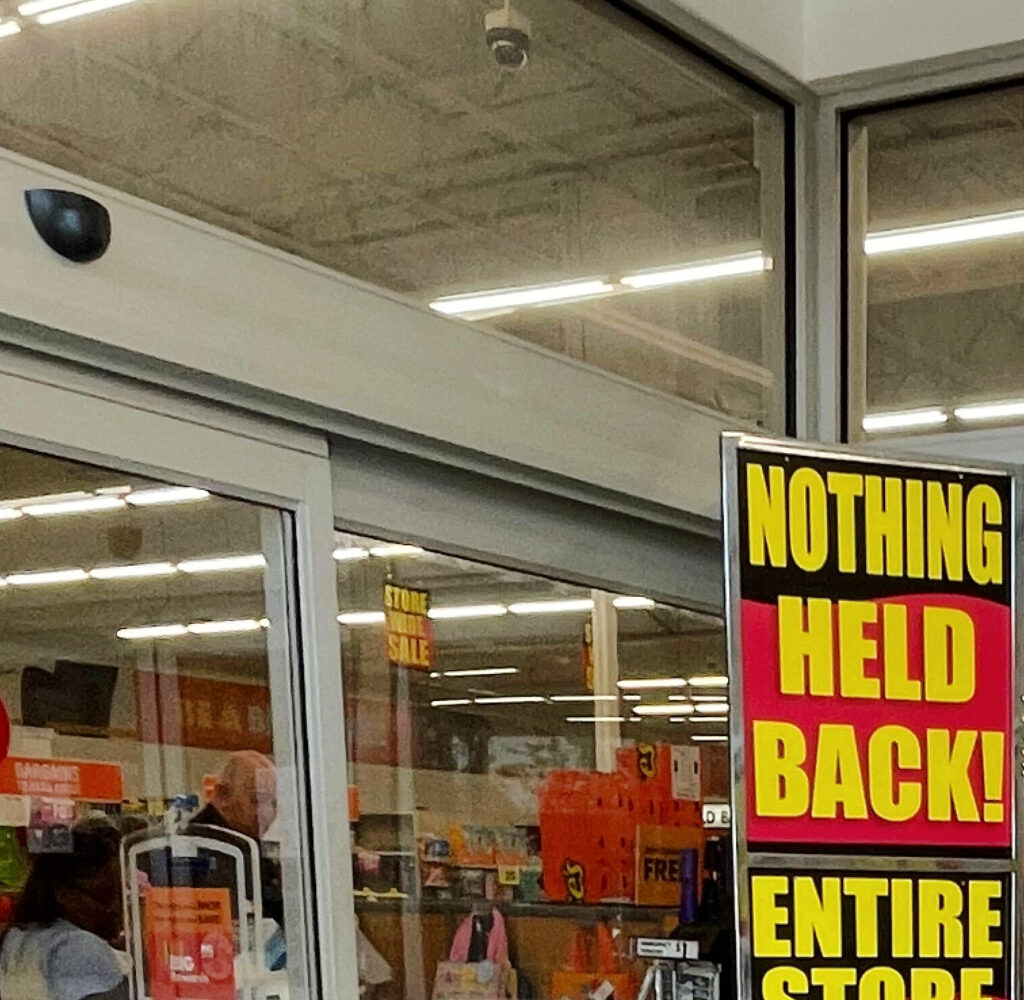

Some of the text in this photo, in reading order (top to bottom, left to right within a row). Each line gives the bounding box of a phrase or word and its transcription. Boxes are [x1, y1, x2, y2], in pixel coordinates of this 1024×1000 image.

[747, 463, 1003, 586] NOTHING
[385, 585, 428, 615] STORE
[388, 633, 430, 667] SALE
[778, 595, 976, 703] HELD
[753, 720, 1005, 822] BACK!
[643, 857, 682, 882] FRE
[751, 876, 1003, 958] ENTIRE
